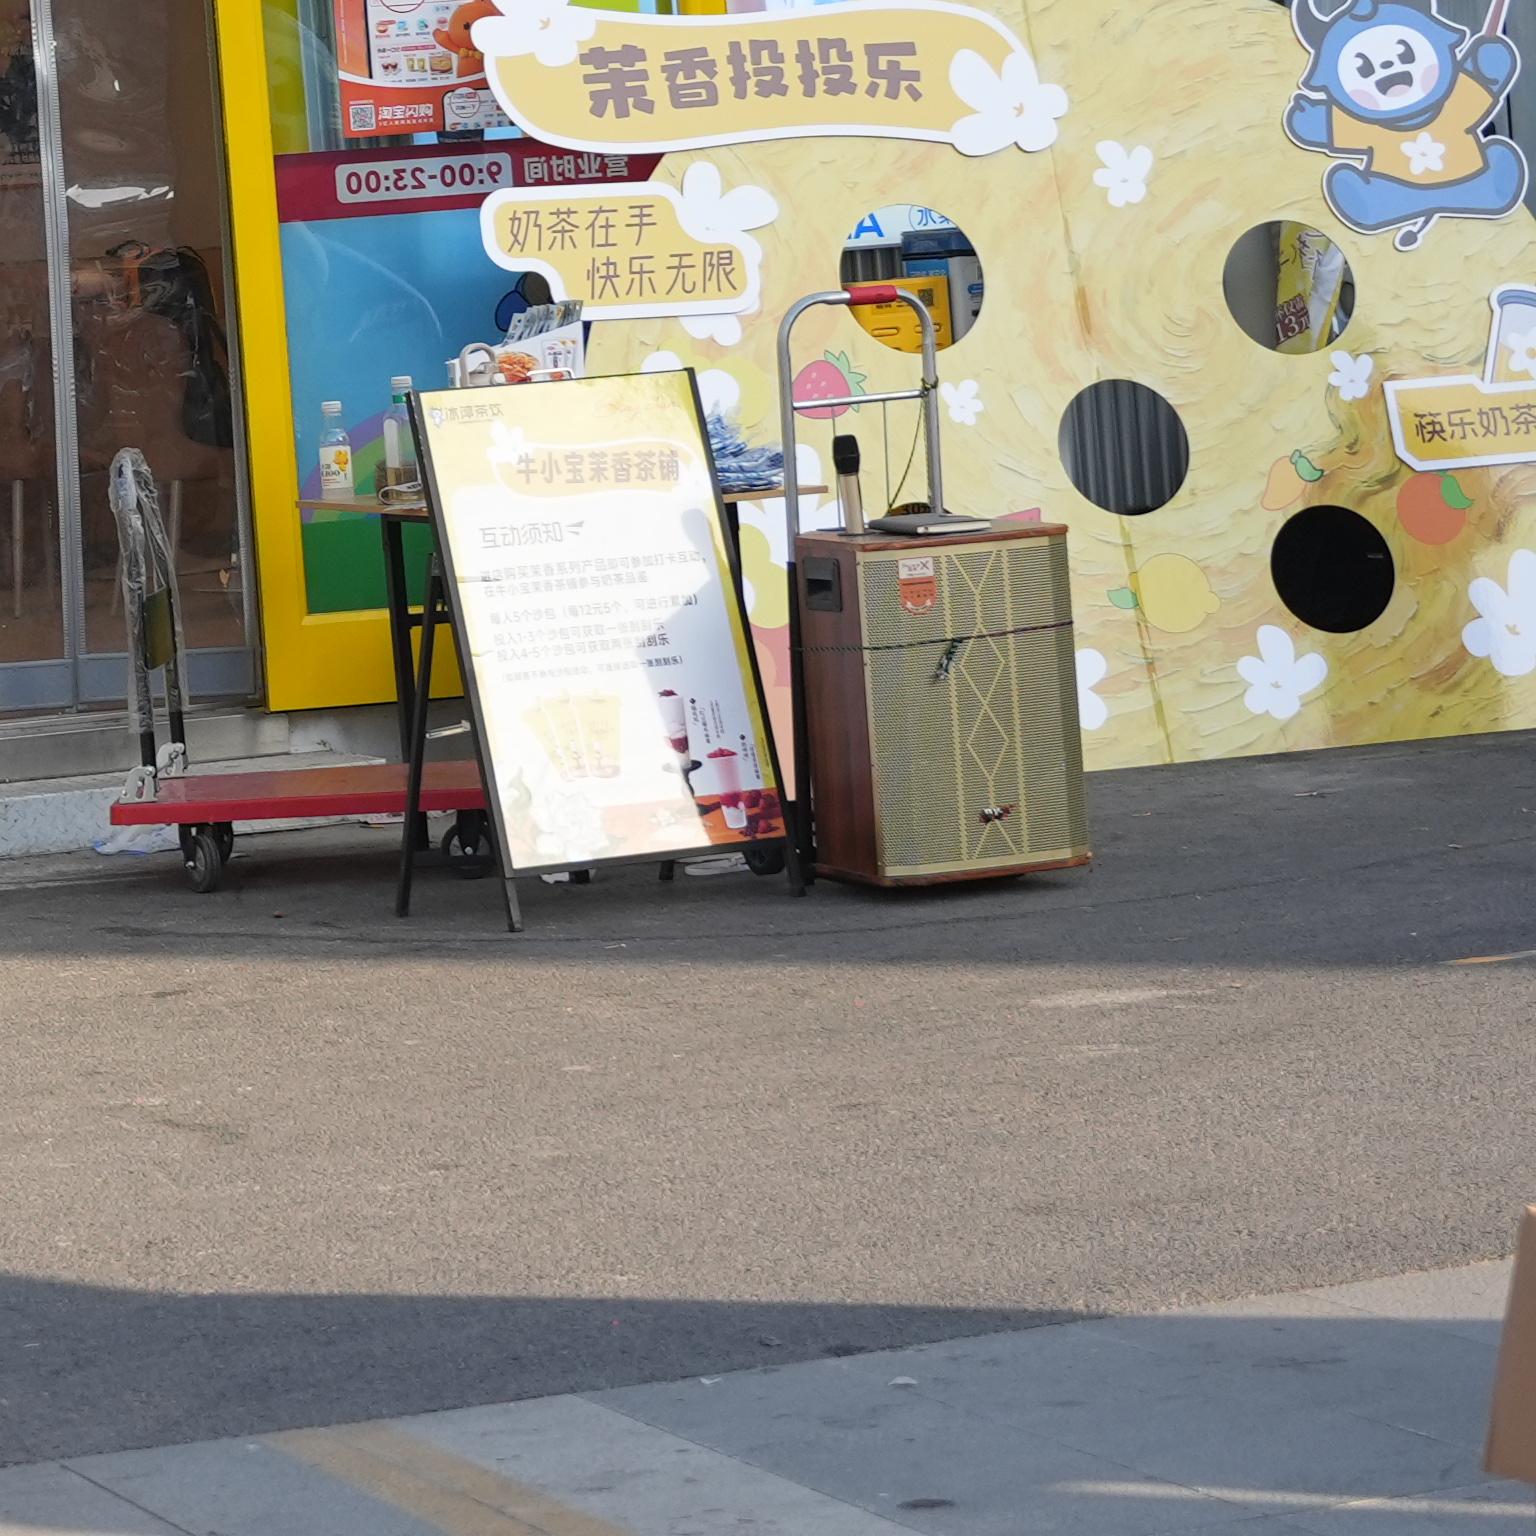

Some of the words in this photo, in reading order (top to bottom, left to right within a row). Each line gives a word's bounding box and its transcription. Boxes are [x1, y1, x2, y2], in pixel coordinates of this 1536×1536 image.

[579, 38, 922, 119] 茉香投投乐
[379, 104, 433, 120] 淘宝闪购
[508, 204, 658, 253] 奶茶在手
[586, 250, 737, 300] 快乐无限
[516, 450, 679, 484] 牛小宝茉香茶铺
[480, 522, 563, 548] 互动须知
